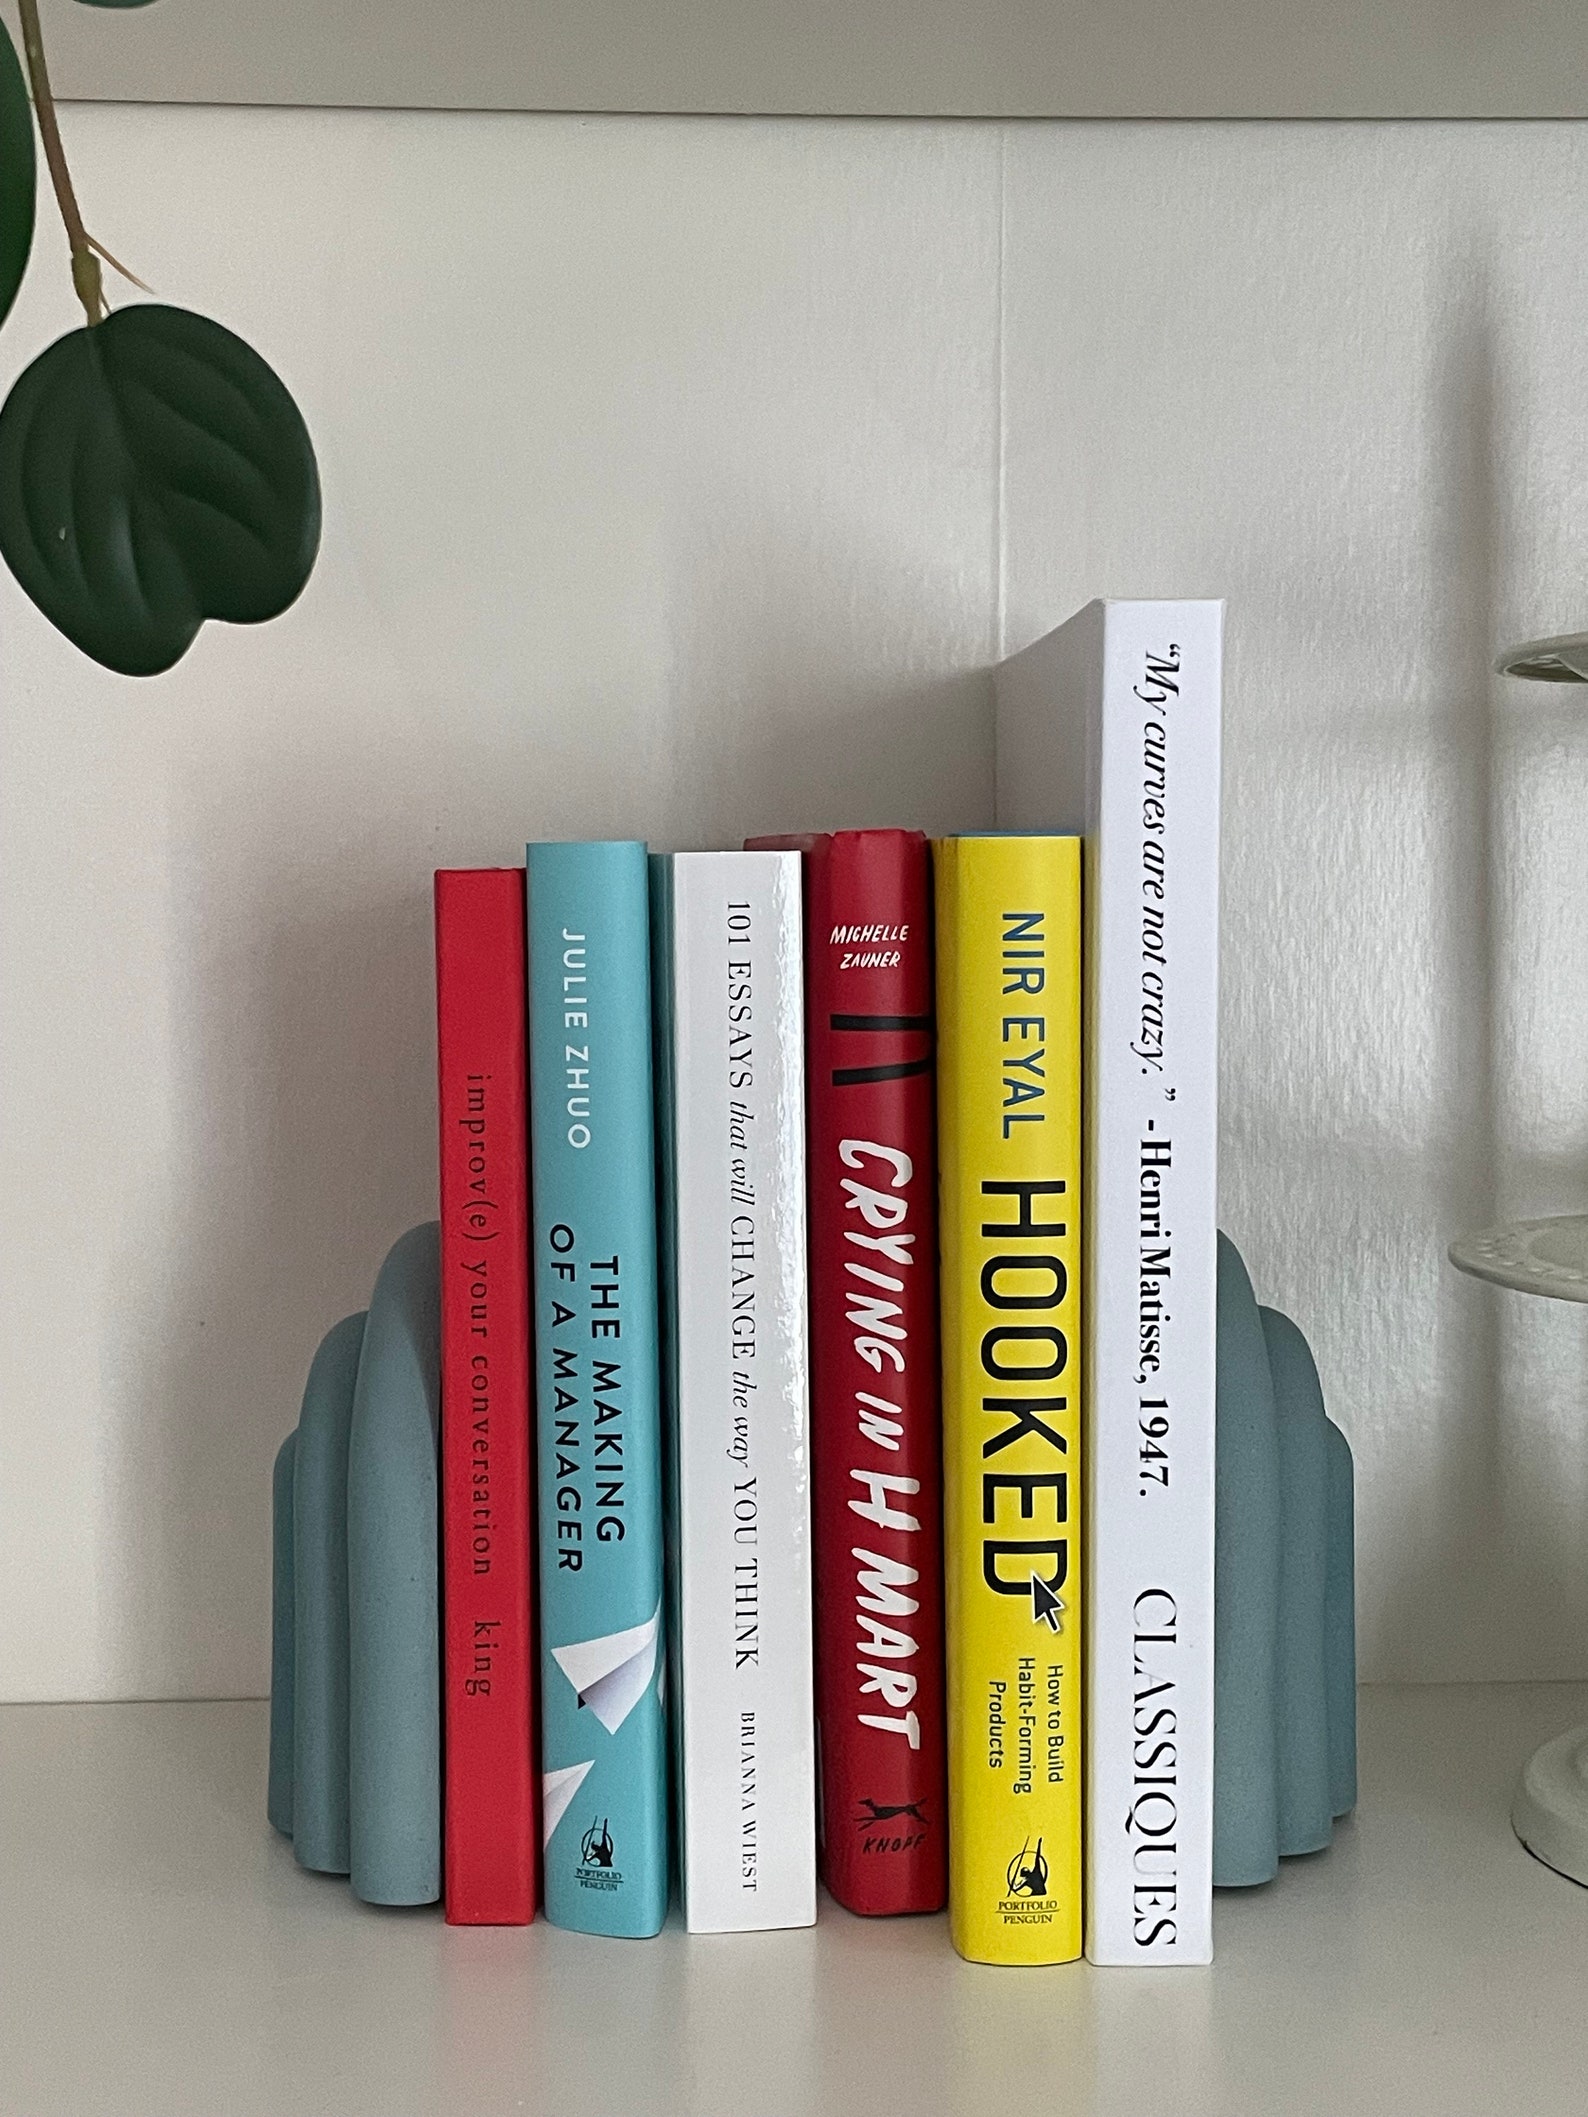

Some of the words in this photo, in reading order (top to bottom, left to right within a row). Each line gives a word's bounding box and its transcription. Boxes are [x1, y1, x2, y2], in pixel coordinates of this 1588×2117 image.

[1141, 719, 1167, 834] curves
[1141, 838, 1166, 899] are
[726, 900, 752, 946] 101
[829, 922, 910, 946] MICHELLE
[839, 949, 902, 970] ZAUNER
[1001, 912, 1045, 997] NIR
[1141, 905, 1168, 966] not
[561, 928, 589, 1030] JULIE
[726, 959, 754, 1090] ESSAYS
[565, 1044, 592, 1150] ZHUO
[1001, 1016, 1045, 1141] EYAL
[458, 1074, 500, 1243] improv(e)
[728, 1100, 755, 1151] that
[730, 1158, 756, 1206] will
[1138, 1140, 1172, 1241] Henri
[549, 1222, 577, 1283] OF
[729, 1214, 757, 1361] CHANGE
[838, 1138, 917, 1373] CRYING
[460, 1258, 490, 1338] your
[551, 1300, 577, 1330] A
[589, 1254, 621, 1339] THE
[1131, 1246, 1172, 1385] Matisse,
[732, 1367, 758, 1409] the
[854, 1391, 905, 1452] IN
[979, 1179, 1069, 1596] HOOKED
[468, 1354, 498, 1576] conversation
[552, 1348, 584, 1573] MANAGER
[591, 1360, 626, 1544] MAKING
[725, 1416, 749, 1470] way
[1137, 1395, 1171, 1497] 1947.
[732, 1477, 759, 1546] YOU
[847, 1468, 922, 1533] H
[733, 1557, 760, 1670] THINK
[850, 1547, 921, 1751] MART
[465, 1619, 501, 1698] king
[1046, 1664, 1065, 1707] How
[987, 1680, 1008, 1769] Products
[1012, 1656, 1038, 1795] Habit-Forming
[1048, 1709, 1062, 1730] to
[740, 1711, 757, 1812] BRIANNA
[1047, 1736, 1065, 1783] Build
[1124, 1587, 1178, 1948] CLASSIQUES
[575, 1867, 622, 1880] PORTFOLIO
[740, 1819, 758, 1893] WIEST
[861, 1834, 926, 1855] KNOPF
[580, 1880, 618, 1891] PENGUIN
[997, 1899, 1059, 1912] PORTFOLIO
[1002, 1913, 1055, 1925] PENGUIN
